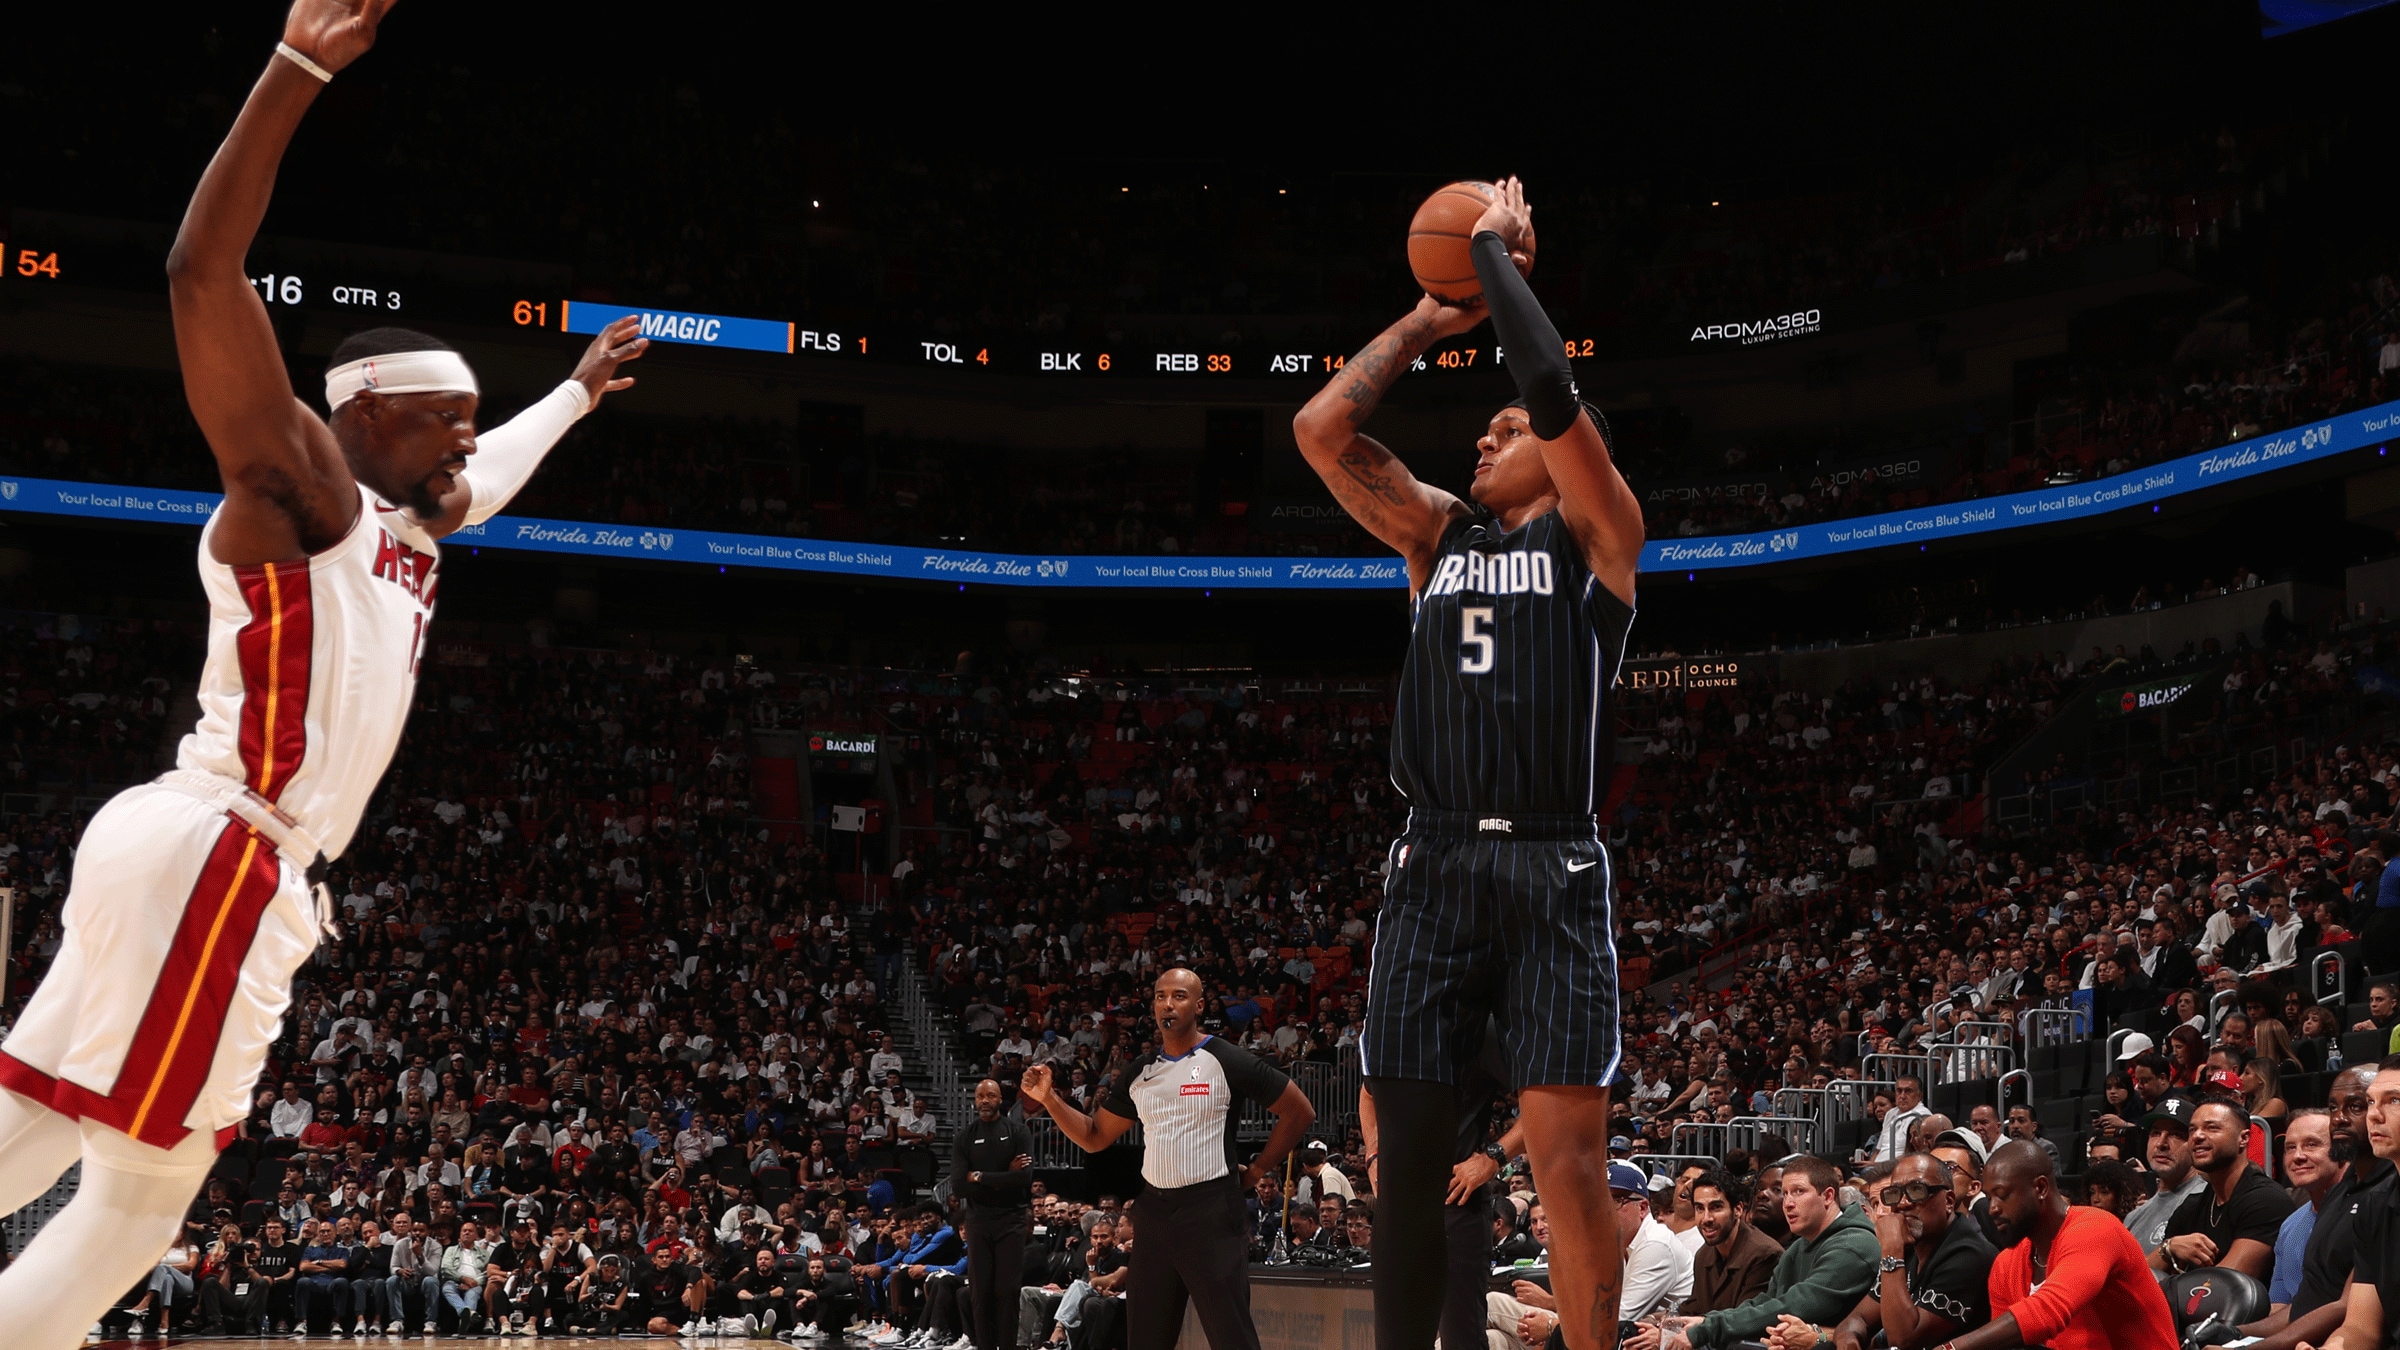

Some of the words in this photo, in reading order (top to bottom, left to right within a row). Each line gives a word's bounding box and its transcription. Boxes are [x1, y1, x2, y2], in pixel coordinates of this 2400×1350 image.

[17, 249, 61, 279] 54
[332, 286, 377, 307] QTR
[386, 291, 401, 310] 3
[513, 299, 546, 327] 61
[640, 312, 721, 343] MAGIC
[1690, 309, 1821, 342] AROMA360
[1741, 332, 1775, 345] LUXURY
[1778, 323, 1821, 340] SCENTING
[801, 330, 841, 352] FLS
[858, 336, 867, 354] 1
[920, 342, 964, 364] TOL
[976, 348, 989, 366] 4
[1040, 352, 1081, 371] BLK
[1097, 353, 1111, 371] 6
[1156, 353, 1199, 372] REB
[1207, 354, 1232, 372] 33
[1270, 354, 1313, 373] AST
[1323, 355, 1344, 373] 14
[1436, 348, 1477, 369] 40.7
[2363, 418, 2388, 432] Your
[2198, 446, 2260, 477] Florida
[2261, 438, 2297, 461] Blue
[57, 491, 88, 505] Your
[90, 494, 122, 508] local
[124, 497, 154, 511] Blue
[157, 500, 193, 514] Cross
[195, 502, 217, 515] Blu
[2011, 504, 2036, 516] Your
[2039, 497, 2065, 512] local
[2068, 495, 2091, 508] Blue
[2094, 491, 2120, 503] Cross
[2122, 484, 2143, 497] Blue
[2144, 472, 2175, 491] Shield
[516, 524, 590, 544] Florida
[592, 530, 634, 548] Blue
[1827, 531, 1851, 543] Your
[1853, 525, 1877, 540] local
[1879, 524, 1902, 536] Blue
[1905, 520, 1934, 532] Cross
[1936, 515, 1960, 527] Blue
[1961, 507, 1996, 524] Shield
[707, 541, 735, 554] Your
[736, 543, 764, 557] local
[766, 546, 792, 559] Blue
[794, 548, 826, 561] Cross
[828, 551, 854, 564] Blue
[856, 552, 892, 567] Shield
[1659, 542, 1727, 562] Florida
[1729, 539, 1766, 557] Blue
[922, 555, 990, 574] Florida
[992, 560, 1032, 577] Blue
[1095, 565, 1120, 577] Your
[1123, 565, 1149, 577] local
[1151, 566, 1176, 577] Blue
[1178, 566, 1208, 578] Cross
[1211, 567, 1236, 578] Blue
[1237, 567, 1273, 578] Shield
[1289, 563, 1357, 579] Florida
[1359, 563, 1397, 579] Blue
[1424, 549, 1555, 602] RLANDO
[409, 611, 430, 681] 1
[1459, 605, 1497, 675] 5
[1689, 663, 1738, 675] OCHO
[1689, 678, 1738, 688] LOUNGE
[826, 739, 877, 754] BACARDÍ
[1478, 817, 1513, 833] MAGIC
[1180, 1086, 1209, 1094] Emirates
